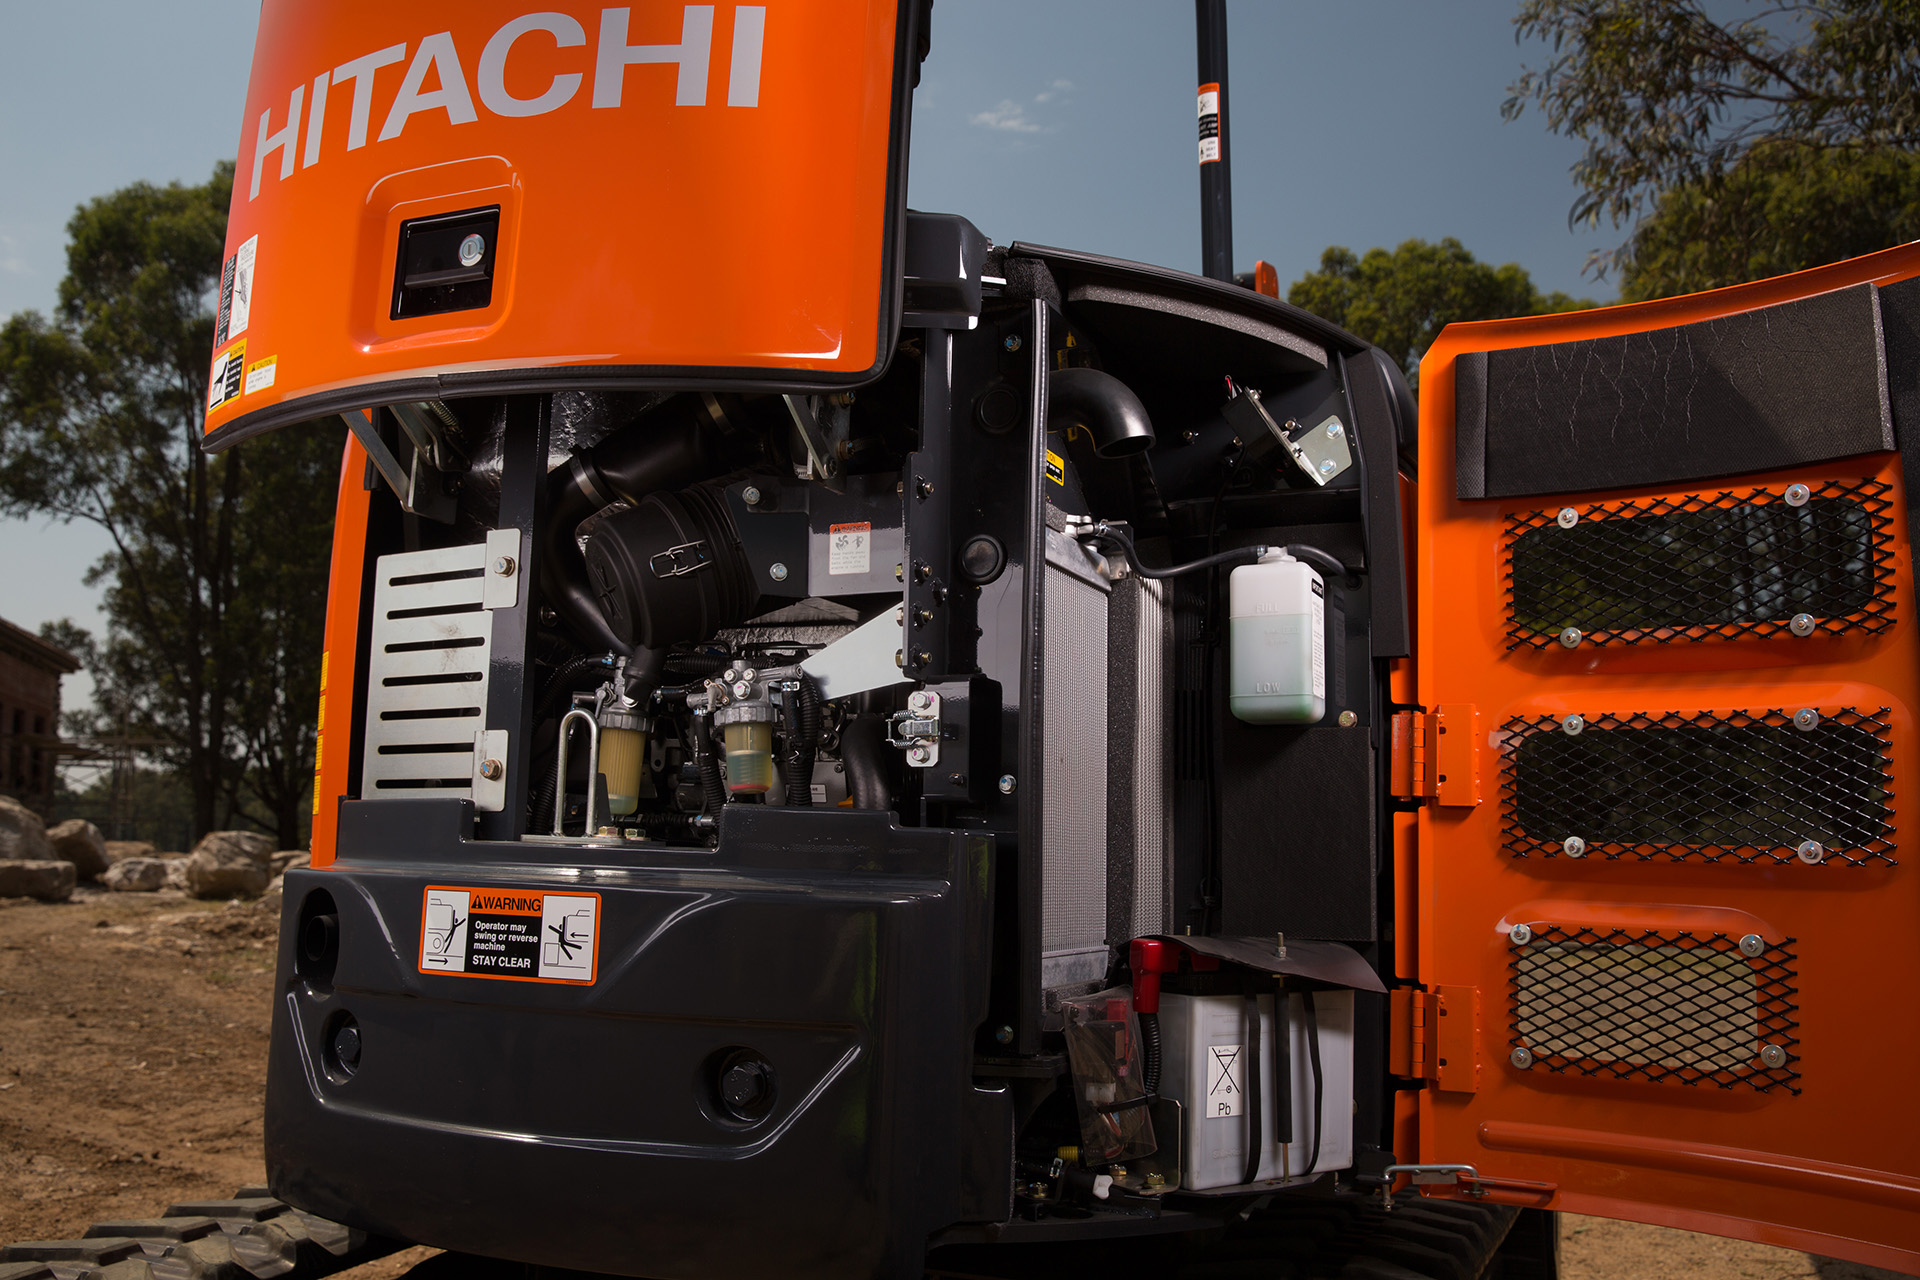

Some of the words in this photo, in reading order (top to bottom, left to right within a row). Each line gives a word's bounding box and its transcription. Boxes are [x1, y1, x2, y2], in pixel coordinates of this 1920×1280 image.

[249, 5, 767, 202] HITACHI
[1256, 682, 1281, 693] LOW
[483, 896, 541, 912] WARNING
[475, 920, 508, 932] Operator
[510, 923, 527, 932] may
[474, 932, 497, 942] swing
[508, 934, 538, 943] reverse
[473, 942, 505, 951] machine
[472, 955, 497, 966] STAY
[498, 956, 531, 968] CLEAR
[1218, 1102, 1231, 1116] Pb
